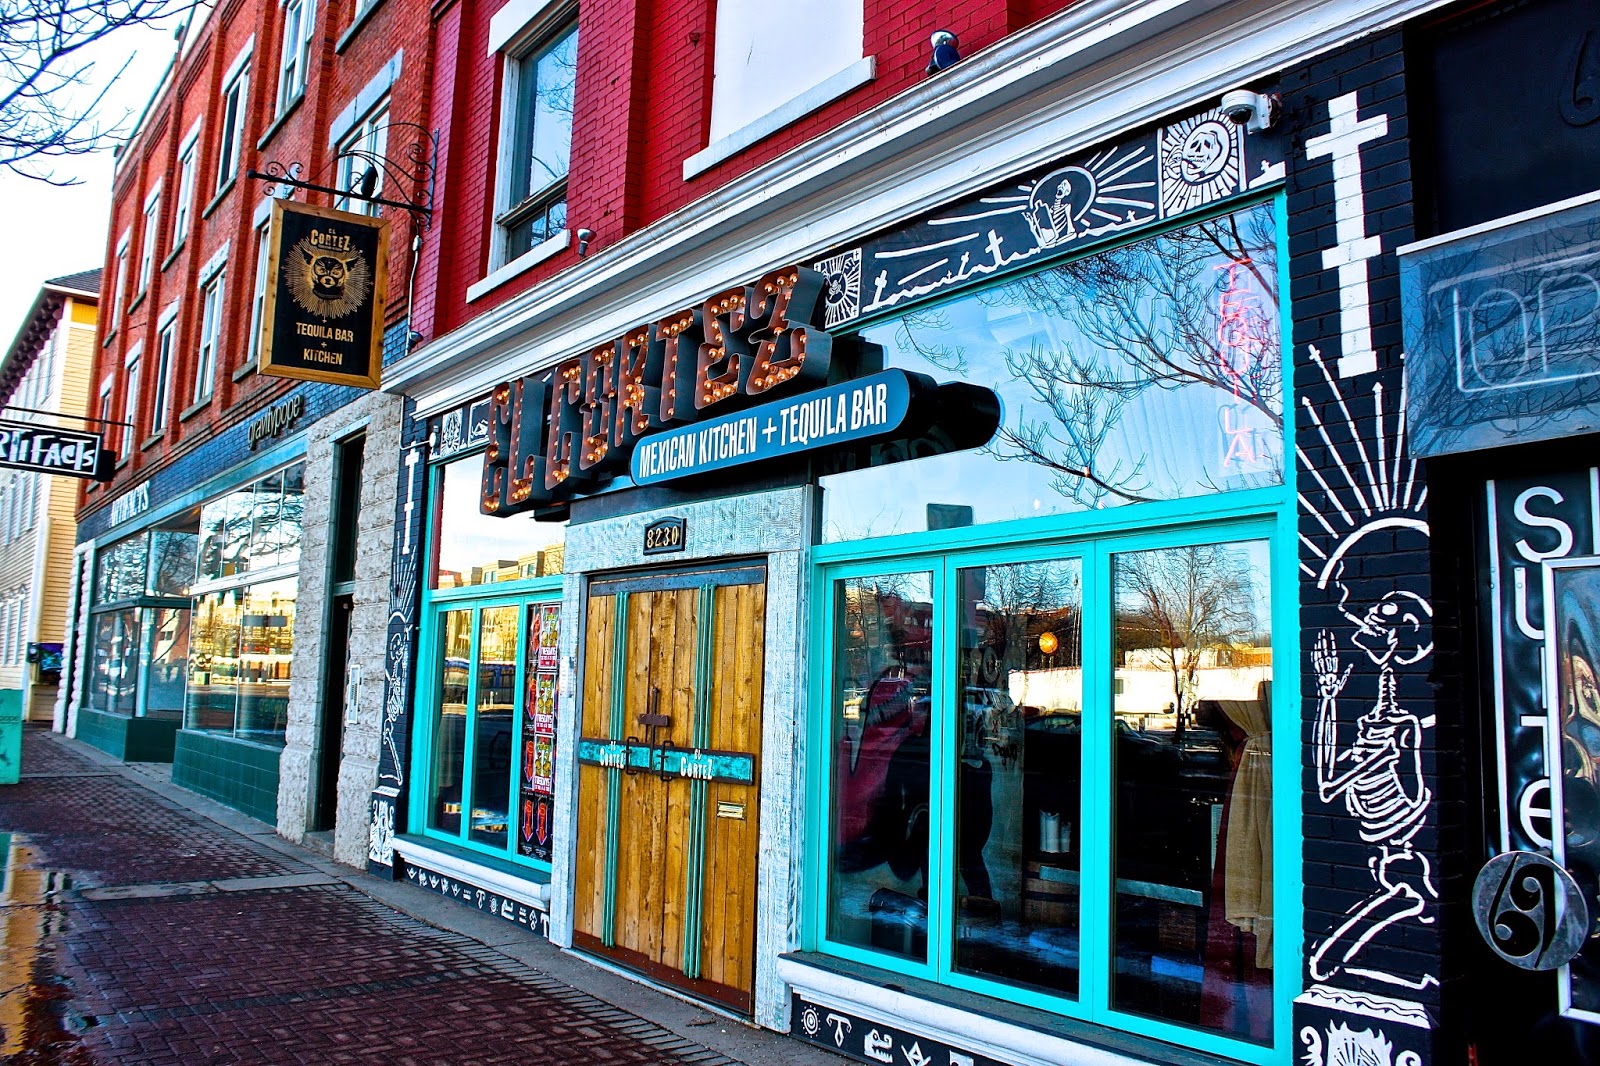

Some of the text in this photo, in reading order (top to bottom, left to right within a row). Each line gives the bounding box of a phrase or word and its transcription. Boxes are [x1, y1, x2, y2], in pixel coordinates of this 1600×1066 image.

[310, 229, 351, 251] CORTEZ
[296, 321, 354, 343] TEQUILA BAR
[303, 348, 343, 366] KITCHEN
[479, 265, 832, 516] EL CORTEZ
[639, 431, 696, 479] MEXICAN
[697, 416, 758, 466] KITCHEN
[779, 394, 847, 446] TEQUILA
[850, 382, 888, 431] BAR
[646, 525, 680, 549] 8230
[680, 756, 713, 780] CORTEZ
